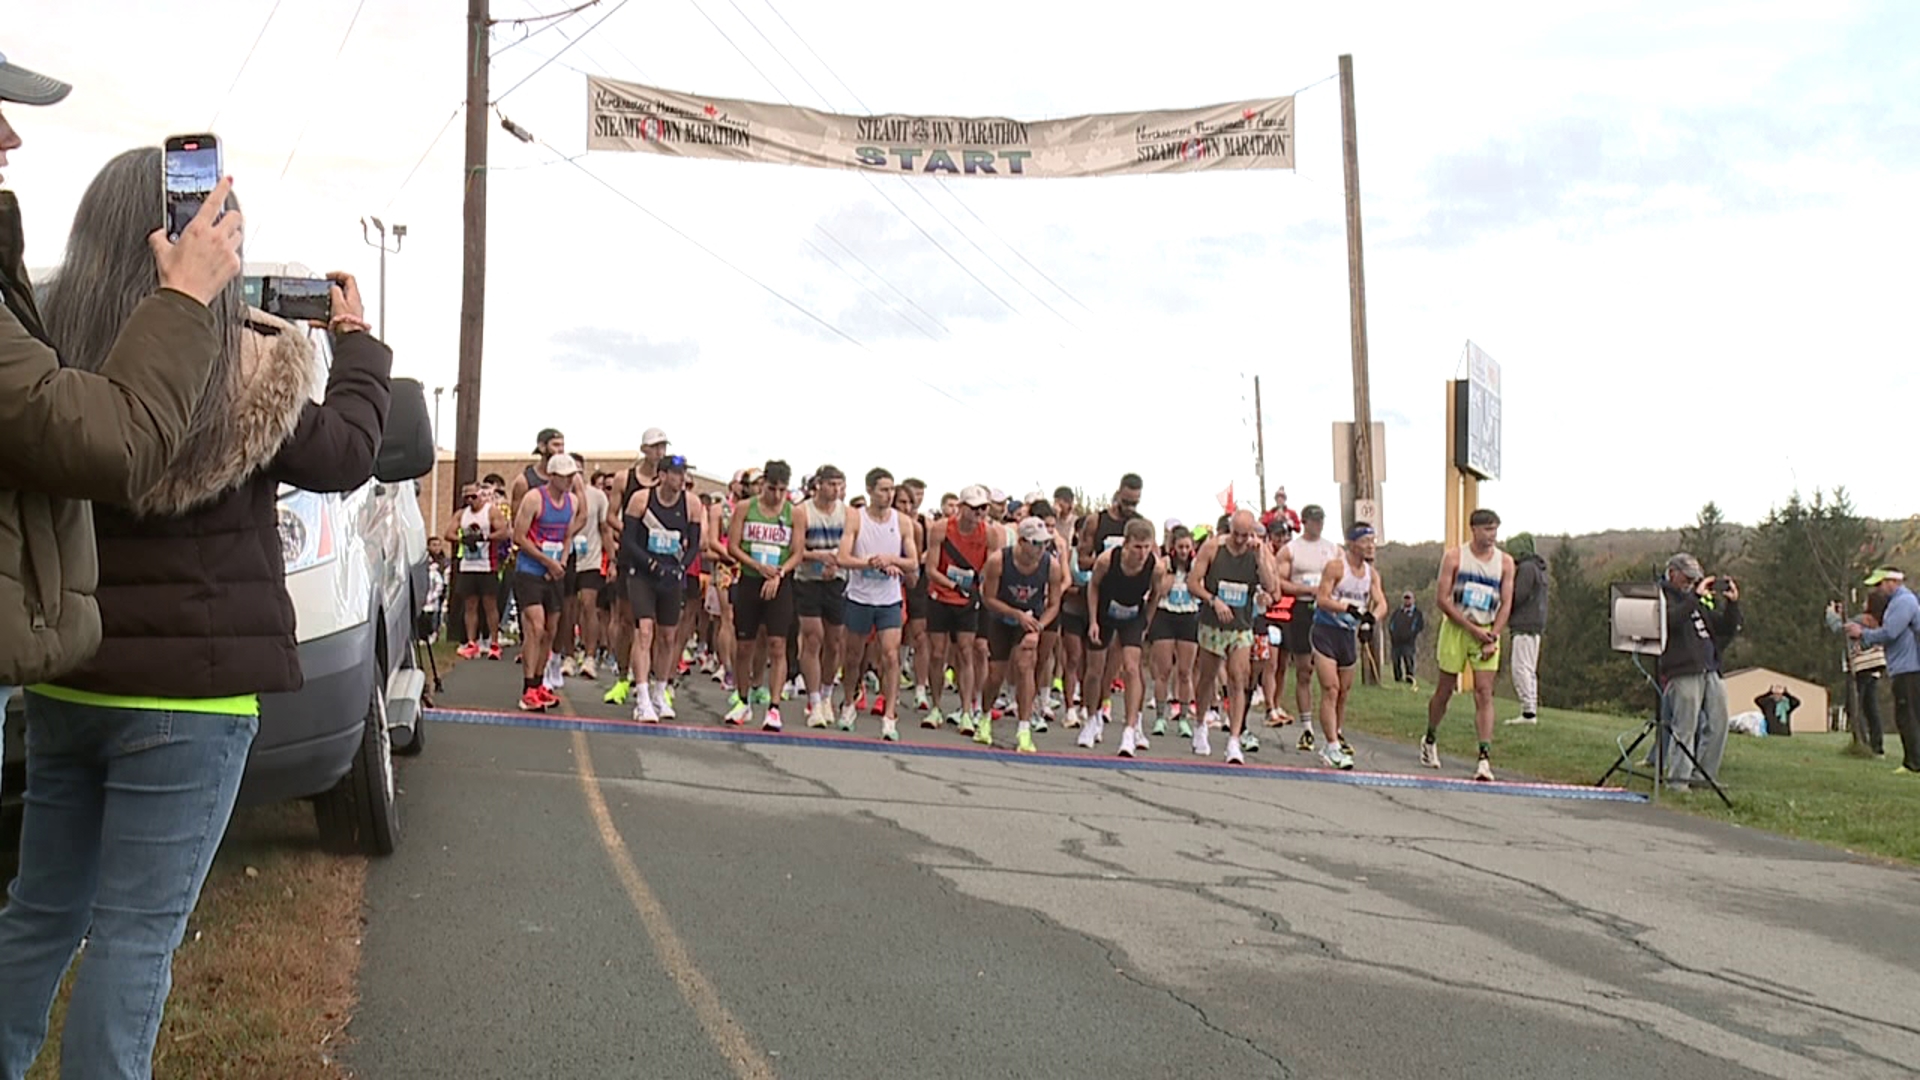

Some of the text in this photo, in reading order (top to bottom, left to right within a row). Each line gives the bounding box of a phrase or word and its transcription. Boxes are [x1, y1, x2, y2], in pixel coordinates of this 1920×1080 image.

[685, 123, 750, 148] MARATHON
[958, 120, 1029, 145] MARATHON
[1225, 134, 1286, 157] MARATHON
[855, 146, 1032, 175] START
